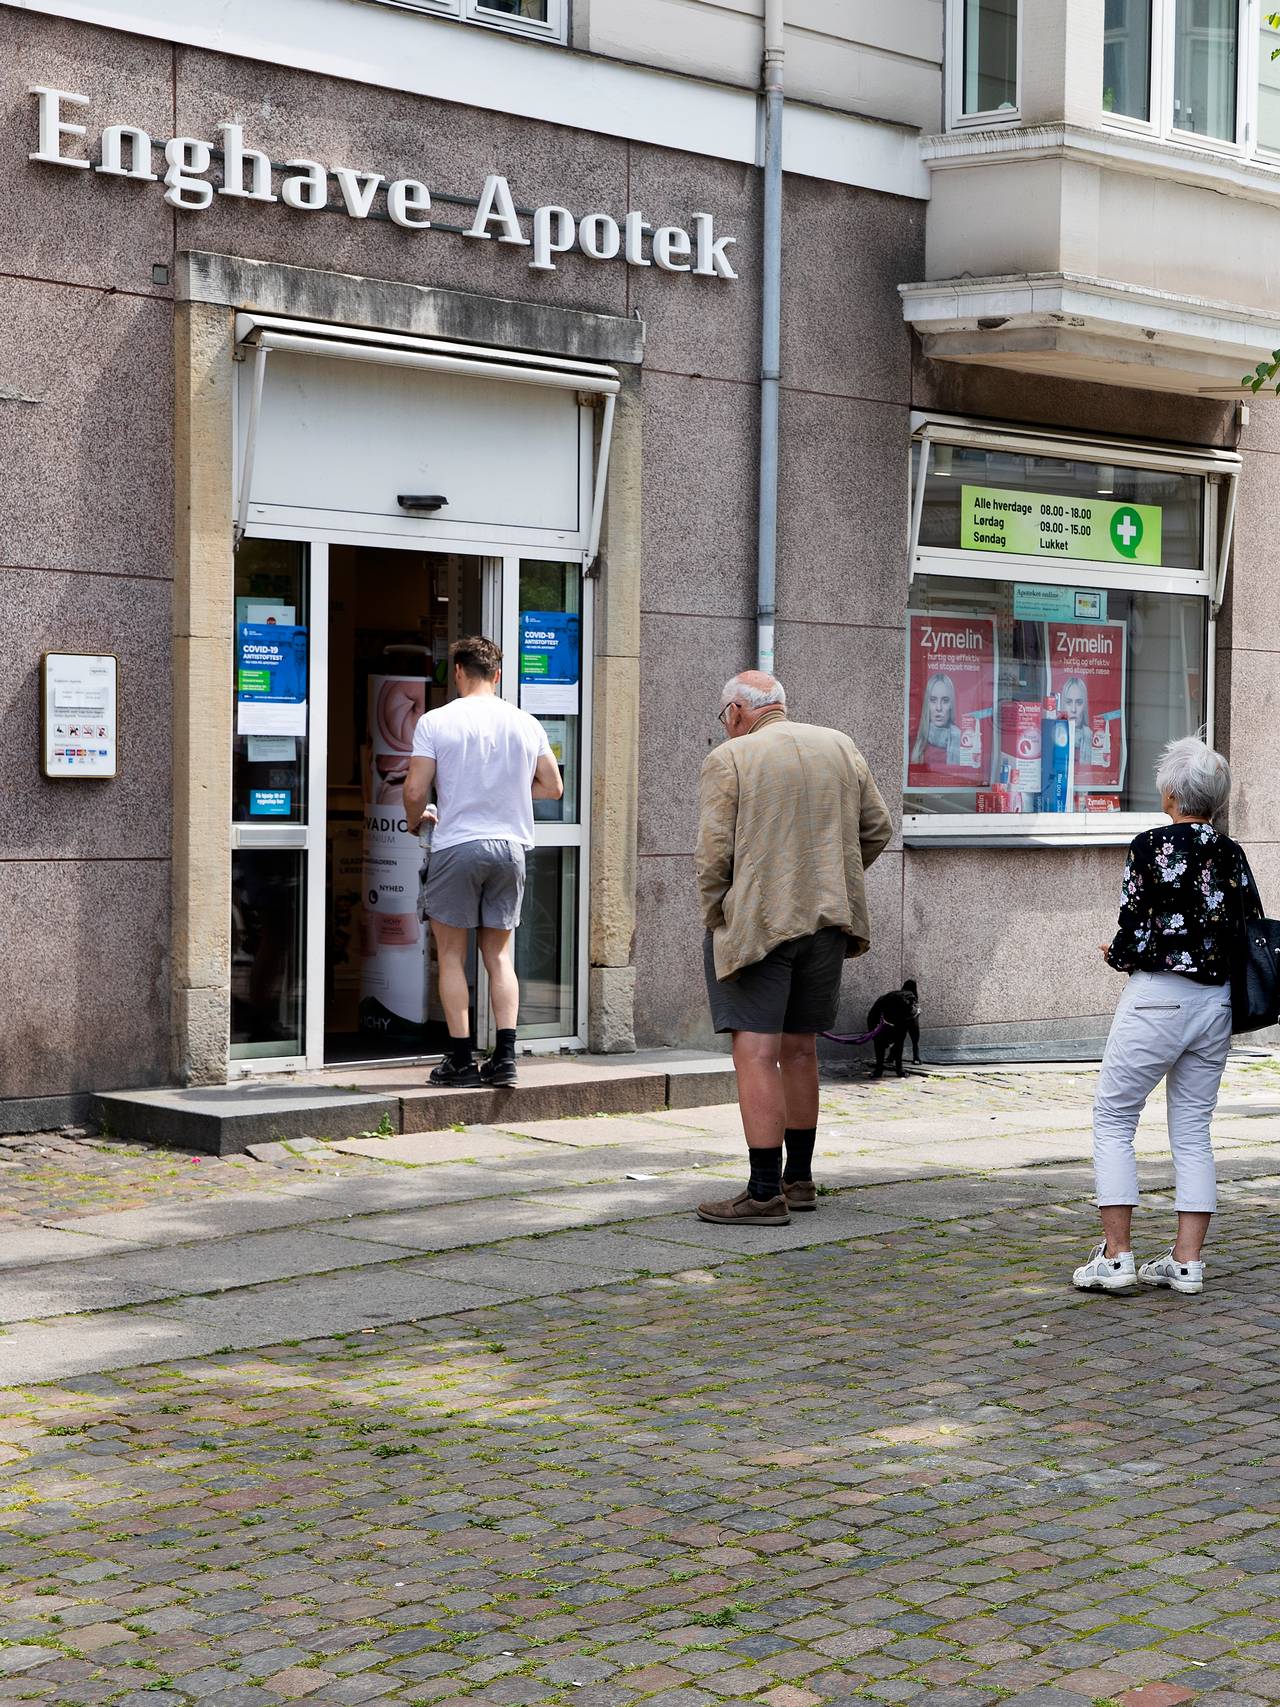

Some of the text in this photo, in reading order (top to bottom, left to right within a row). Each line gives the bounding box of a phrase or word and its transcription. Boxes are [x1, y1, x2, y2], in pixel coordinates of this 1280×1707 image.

[28, 85, 738, 279] Enghave Apotek
[974, 497, 1032, 515] Alle hverdage
[1040, 504, 1064, 517] 08.00
[1070, 507, 1091, 520] 18.00
[974, 514, 1004, 530] Lørdag
[1040, 520, 1063, 534] 09.00
[1070, 523, 1091, 536] 15.00
[973, 531, 1006, 547] Søndag
[1040, 537, 1068, 550] Lukket
[524, 631, 555, 639] COVID-19
[921, 626, 983, 653] Zymelin
[243, 645, 279, 654] COVID-19
[1056, 631, 1112, 656] Zymelin
[928, 662, 939, 670] ved
[947, 655, 955, 663] og
[1081, 658, 1088, 667] og
[1063, 665, 1073, 673] ved
[378, 883, 405, 893] NYHED
